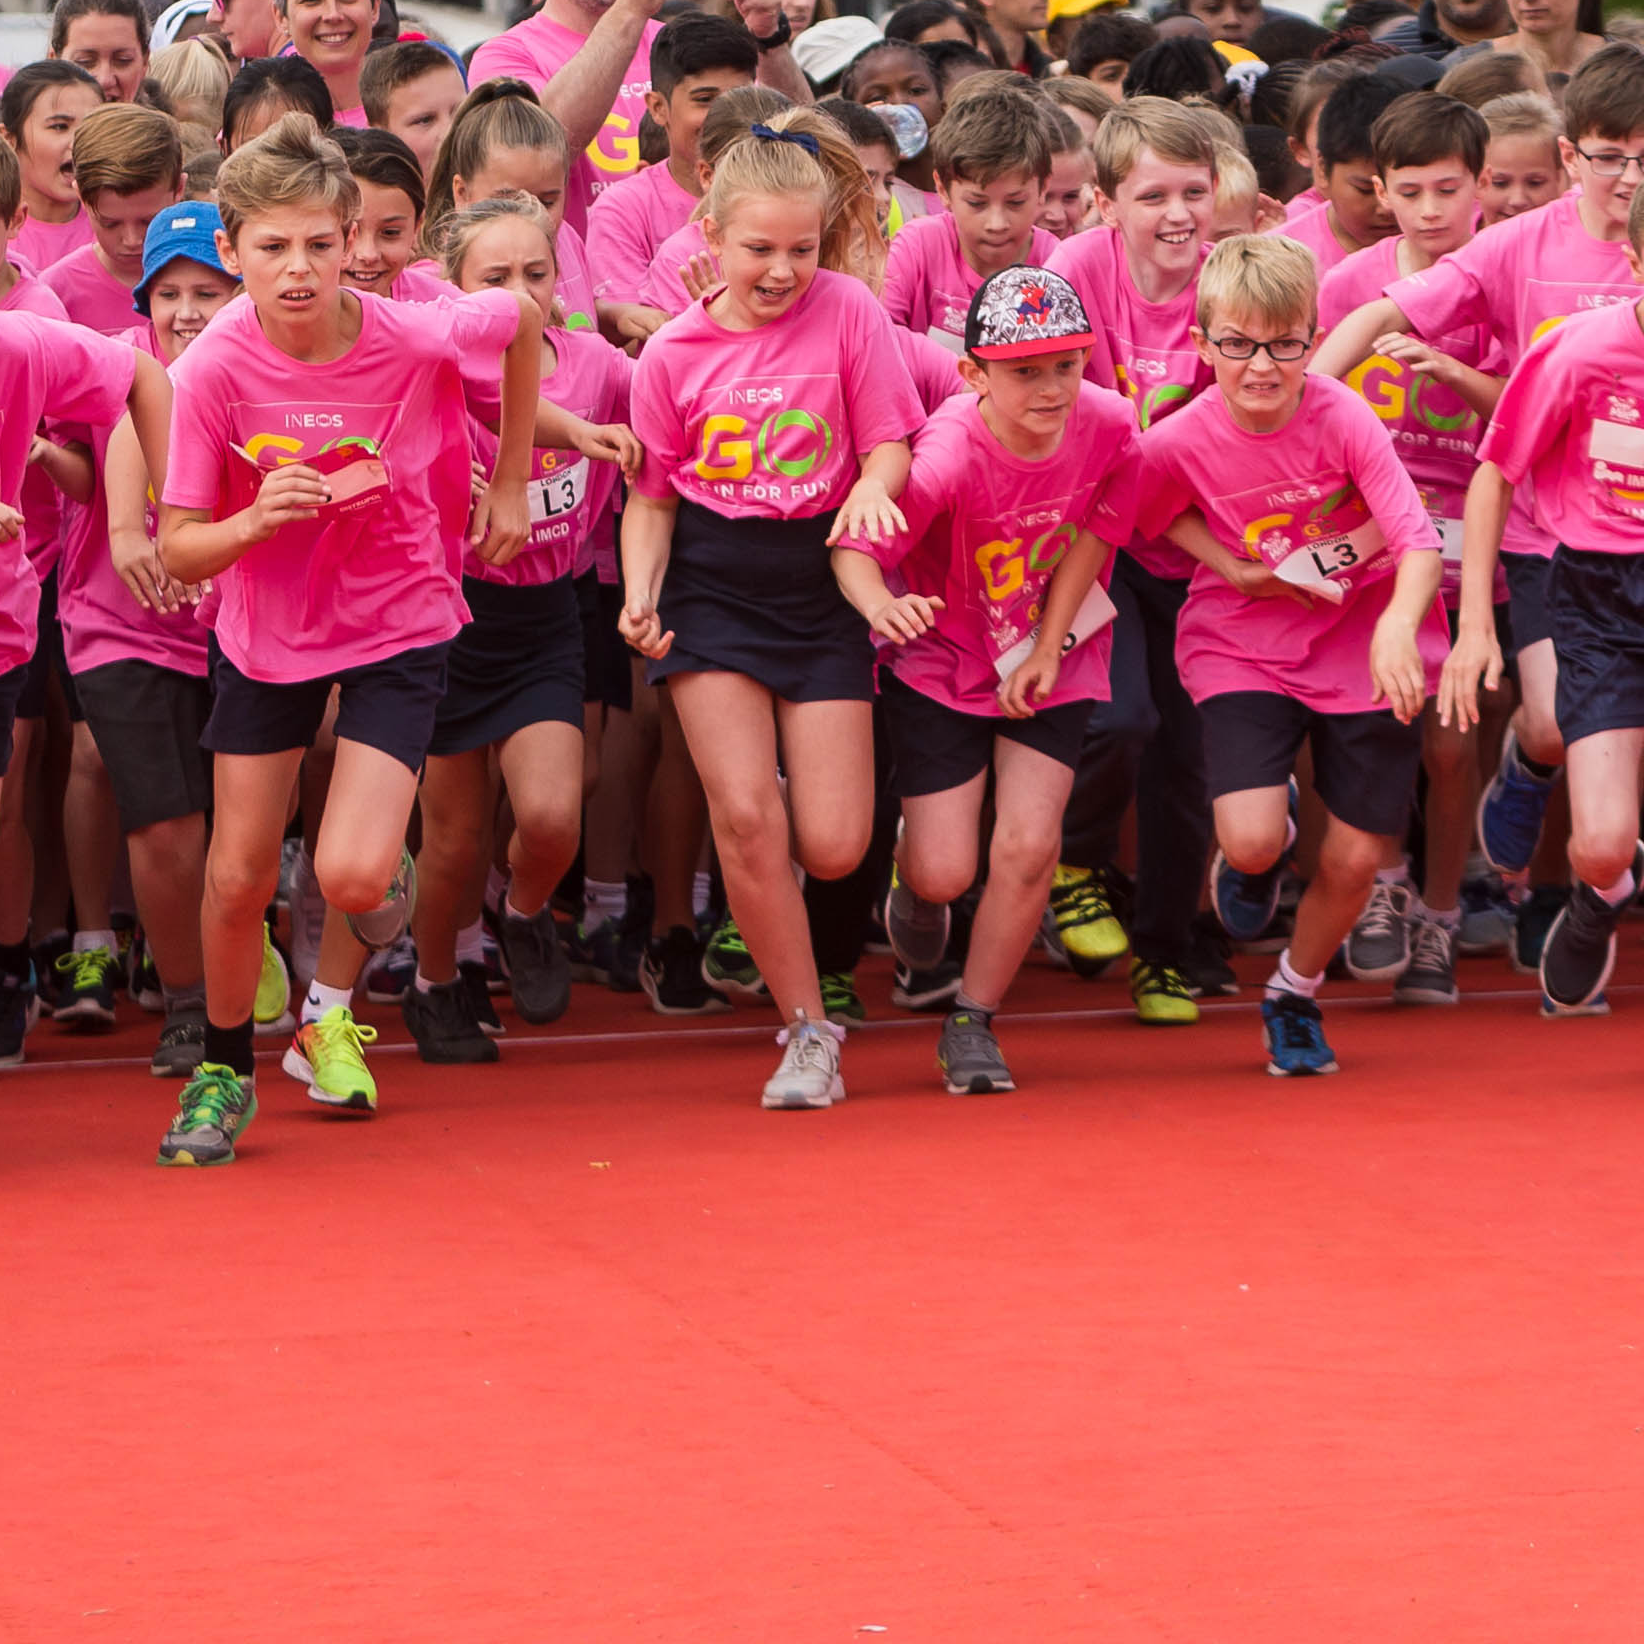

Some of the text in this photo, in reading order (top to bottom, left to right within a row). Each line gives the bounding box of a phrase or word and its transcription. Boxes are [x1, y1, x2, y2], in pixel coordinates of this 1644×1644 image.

[728, 386, 784, 406] INEOS
[285, 413, 344, 429] INEOS
[694, 408, 835, 481] GO
[1435, 436, 1476, 456] FUN
[541, 479, 576, 518] L3
[741, 483, 782, 500] FOR
[789, 479, 833, 499] FUN
[1266, 485, 1322, 509] INEOS
[535, 521, 571, 543] IMCD
[1306, 534, 1350, 552] LONDON
[975, 521, 1078, 603] GO
[1310, 542, 1359, 578] L3
